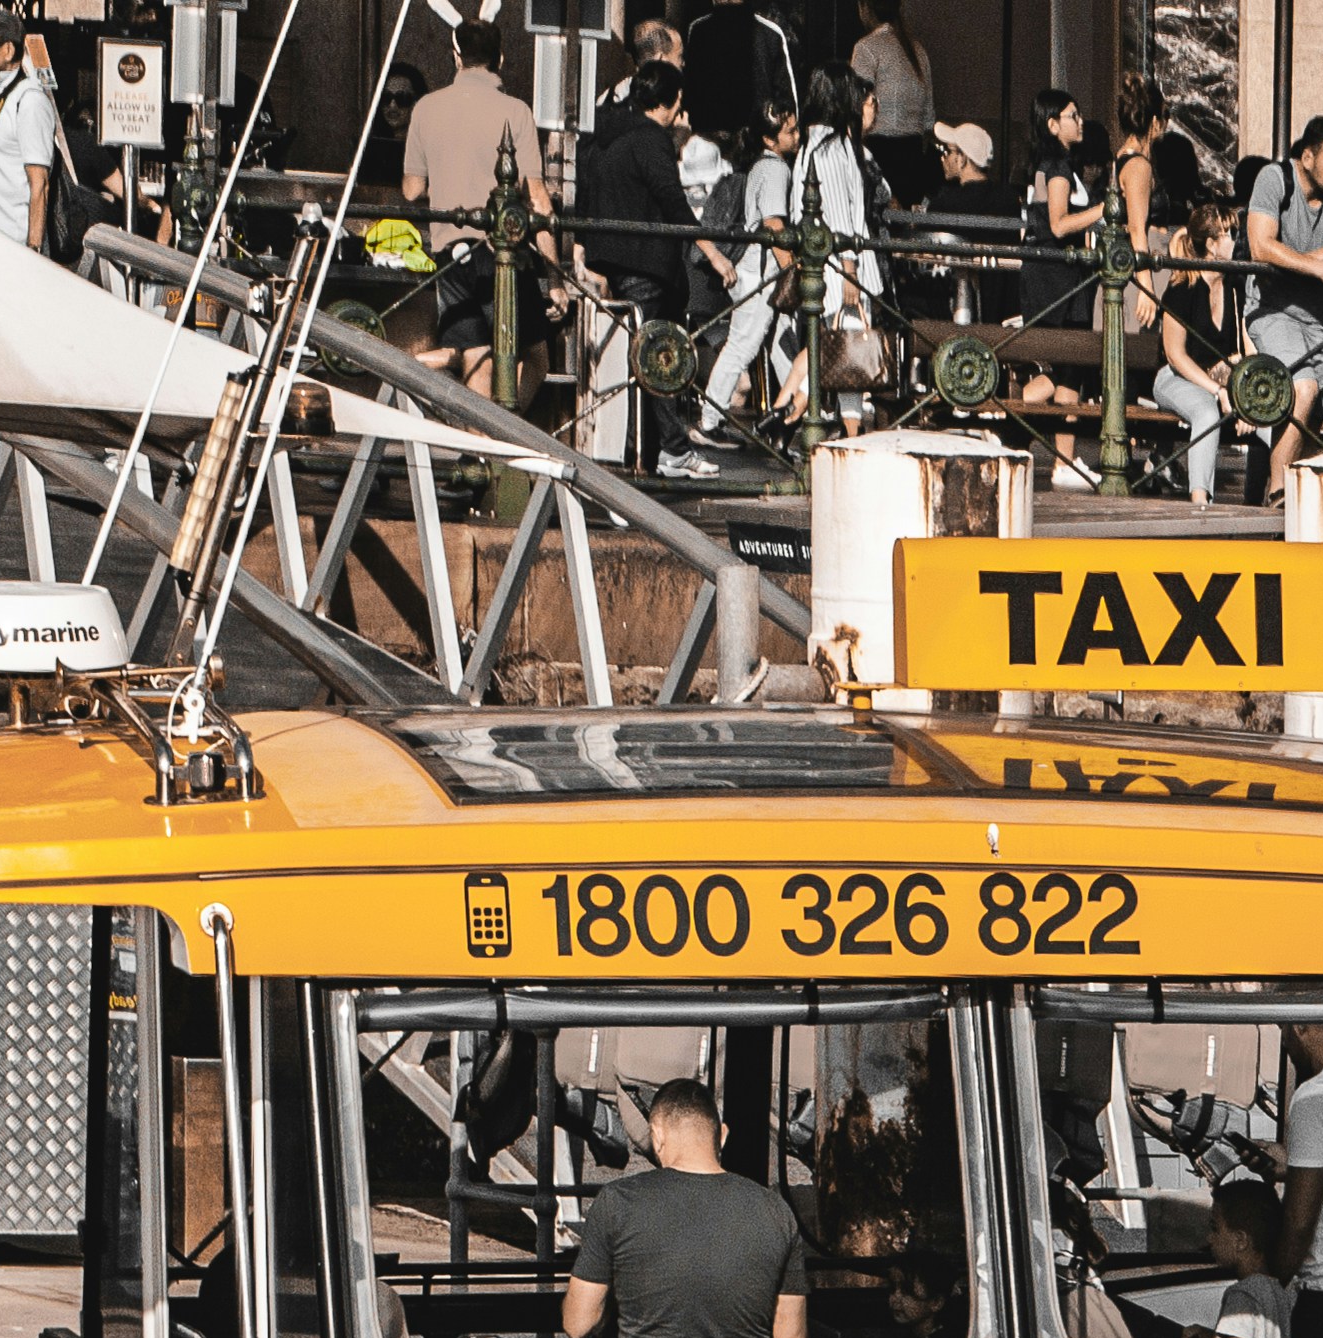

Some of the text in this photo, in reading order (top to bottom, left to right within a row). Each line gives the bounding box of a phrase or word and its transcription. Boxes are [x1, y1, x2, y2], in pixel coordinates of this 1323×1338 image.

[114, 91, 148, 100] PLEASE
[107, 102, 156, 113] ALLOW US
[127, 114, 150, 123] SEAT
[121, 124, 141, 133] YOU
[739, 540, 794, 558] ADVENTURES
[979, 570, 1284, 667] TAXI
[542, 872, 1141, 958] 1800 326 822
